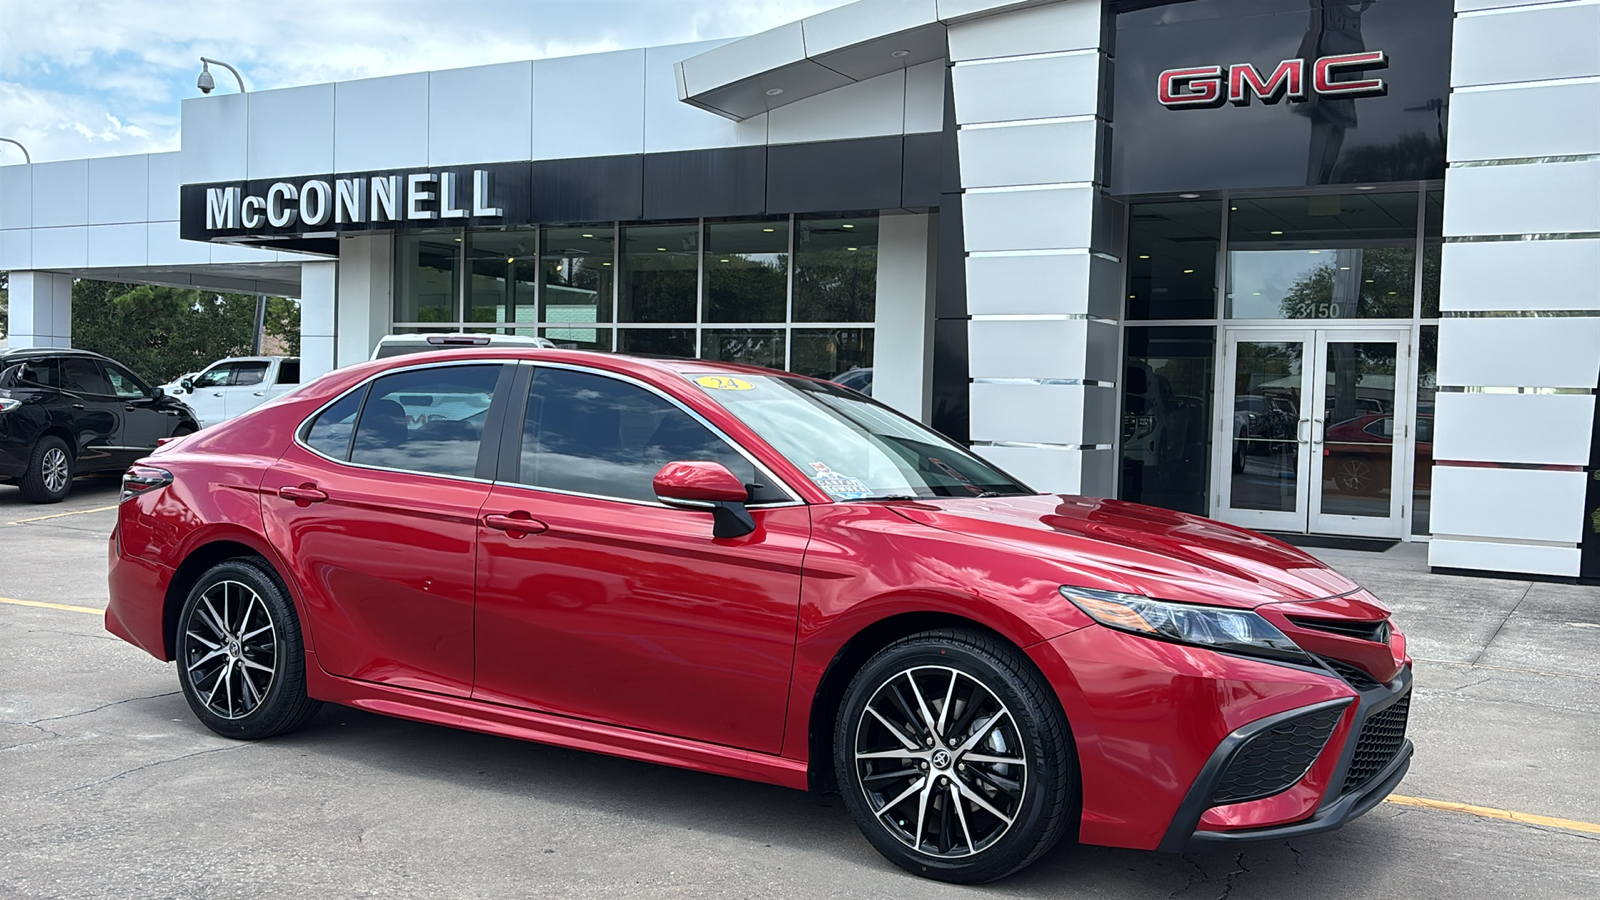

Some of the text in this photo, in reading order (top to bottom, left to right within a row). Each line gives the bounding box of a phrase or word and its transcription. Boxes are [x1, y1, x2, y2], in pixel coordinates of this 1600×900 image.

[1158, 50, 1388, 110] GMC
[205, 169, 503, 230] McCONNELL
[1297, 302, 1340, 319] 3150
[710, 377, 739, 389] 24
